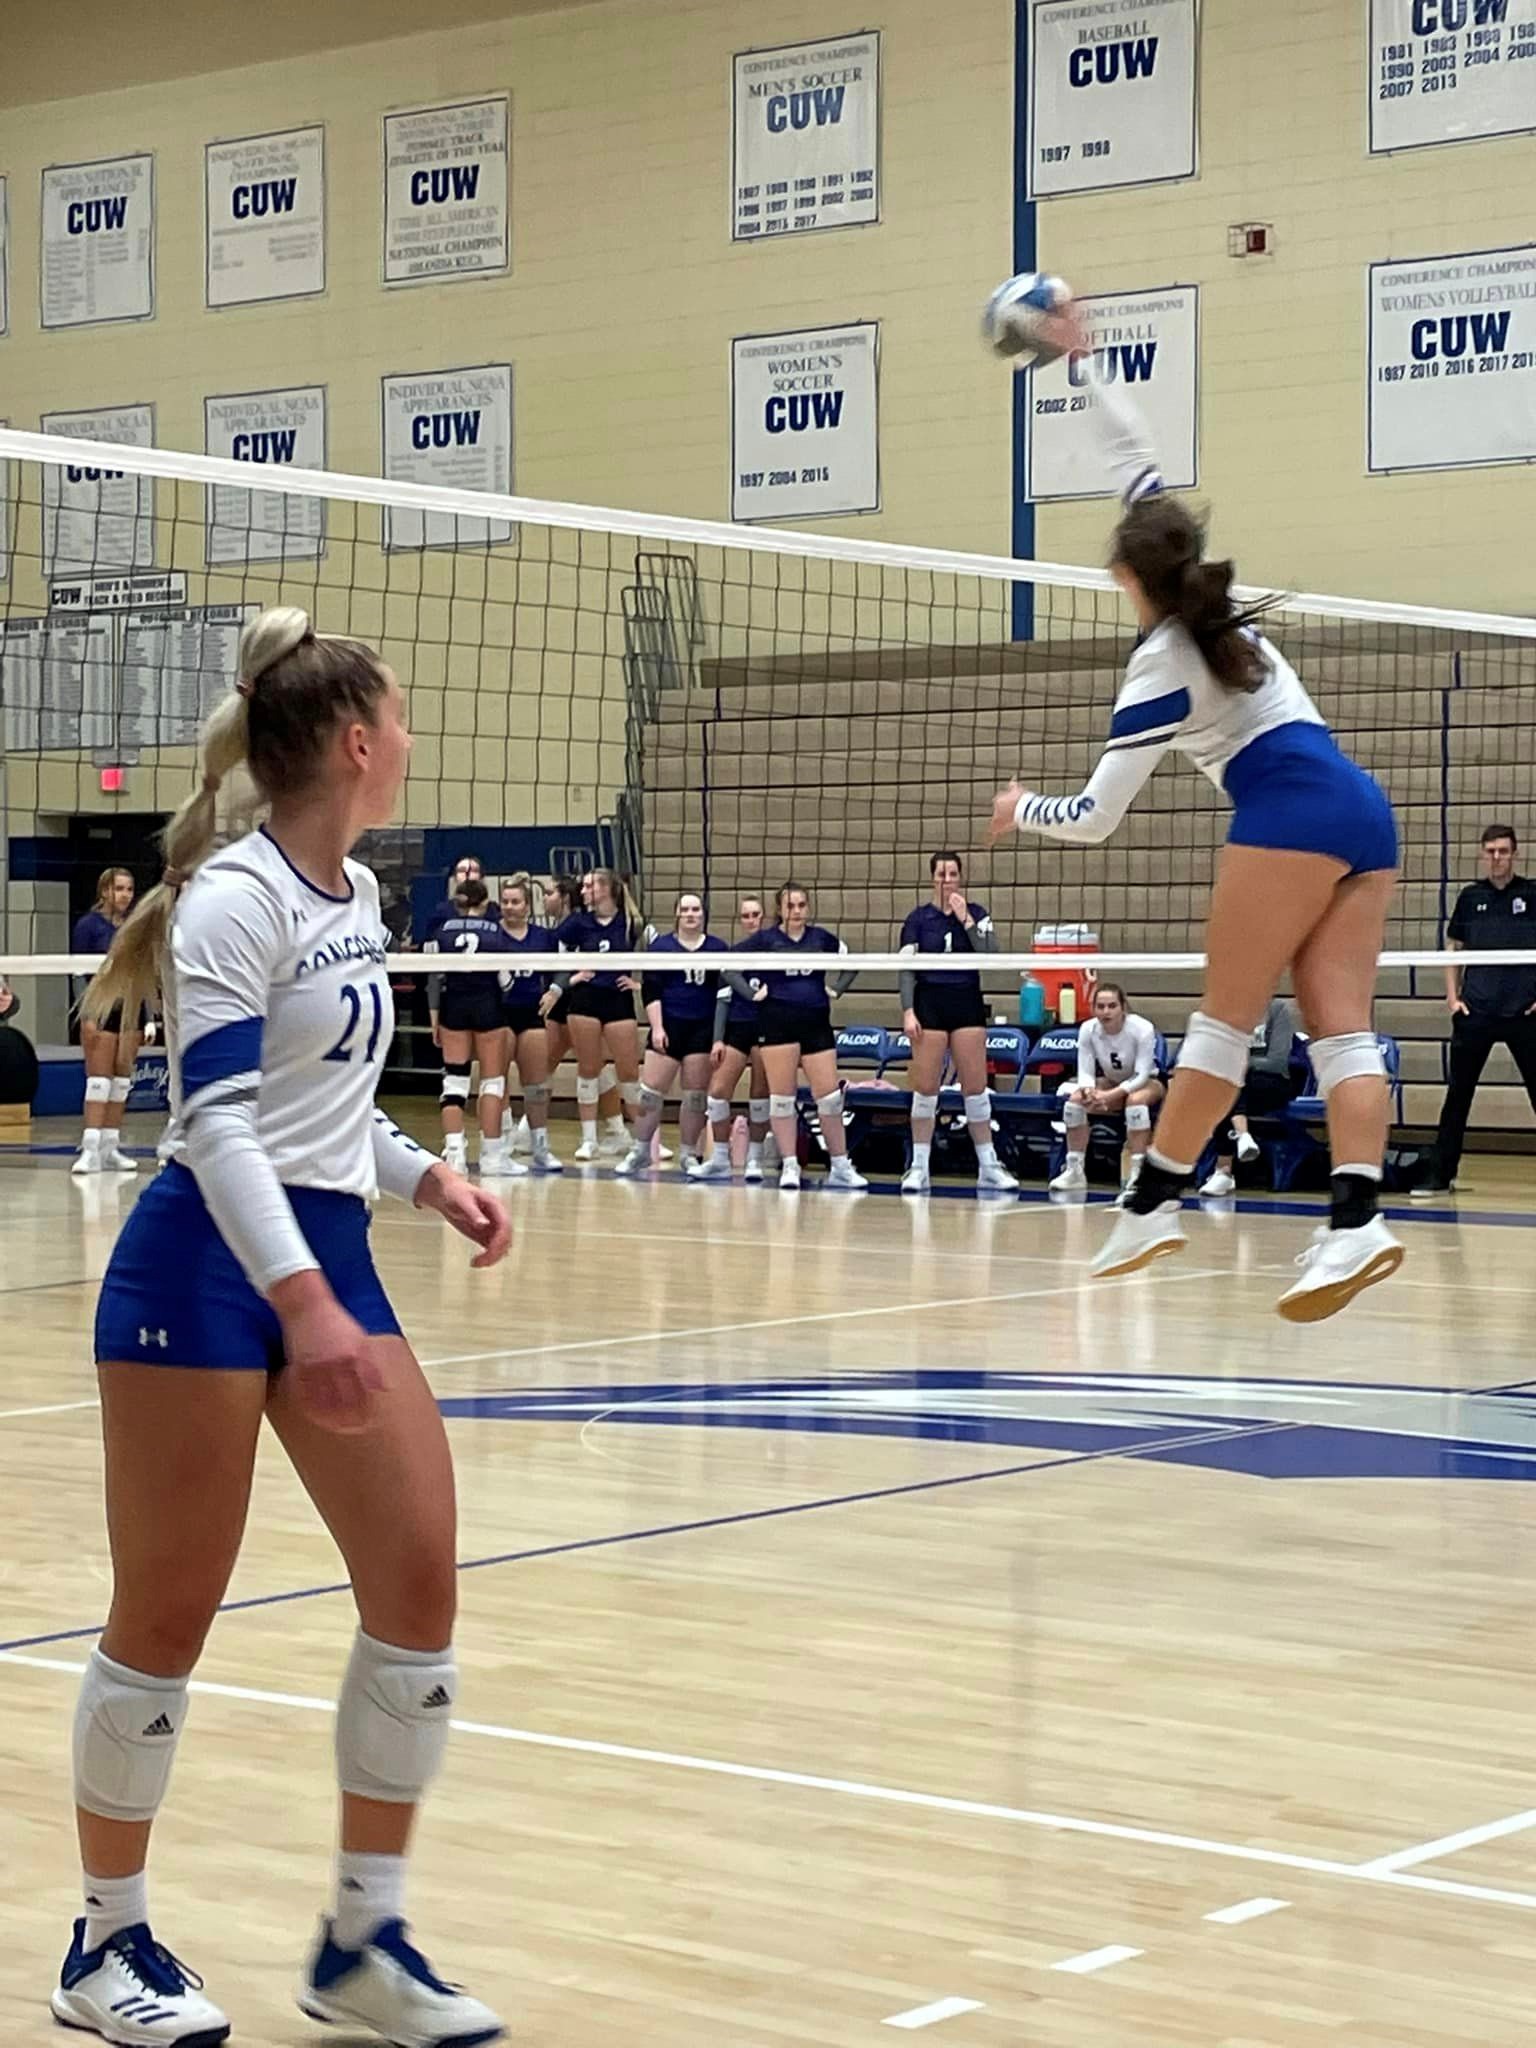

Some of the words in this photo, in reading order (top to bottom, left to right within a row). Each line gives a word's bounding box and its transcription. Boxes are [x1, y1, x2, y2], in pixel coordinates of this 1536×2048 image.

[1042, 3, 1117, 23] CONFERENCE
[1412, 0, 1509, 36] CUW
[1078, 20, 1151, 44] BASEBALL
[1510, 23, 1536, 41] 198
[1069, 37, 1158, 88] CUW
[1422, 55, 1456, 75] 2003
[1464, 48, 1499, 68] 2004
[1507, 43, 1536, 61] 200
[749, 78, 796, 98] MEN'S
[801, 67, 862, 88] SOCCER
[1380, 80, 1413, 100] 2007
[1422, 73, 1457, 93] 2013
[767, 86, 845, 133] CUW
[232, 178, 297, 219] CUW
[411, 164, 480, 206] CUW
[67, 196, 128, 235] CUW
[1381, 269, 1463, 287] CONFERENCE
[1467, 259, 1536, 278] CHAMPION
[1118, 299, 1184, 316] CHAMPIONS
[1080, 323, 1158, 346] OFTBALL
[1412, 310, 1511, 361] CUW
[768, 354, 842, 374] WOMEN'S
[1069, 342, 1157, 387] CUW
[1410, 362, 1439, 379] 2010
[1445, 358, 1475, 375] 2016
[1479, 354, 1509, 372] 2017
[1512, 351, 1536, 369] 201
[389, 380, 465, 400] INDIVIDUAL
[773, 374, 834, 392] SOCCER
[765, 390, 844, 433] CUW
[1036, 399, 1067, 415] 2002
[412, 410, 481, 450] CUW
[233, 429, 296, 464] CUW
[801, 467, 829, 483] 2015
[52, 587, 81, 605] CUW
[321, 982, 383, 1063] 21
[837, 1033, 880, 1046] FALCONS
[985, 1037, 1018, 1049] LCONS
[1040, 1037, 1079, 1050] FALCON
[1110, 1052, 1122, 1070] 5
